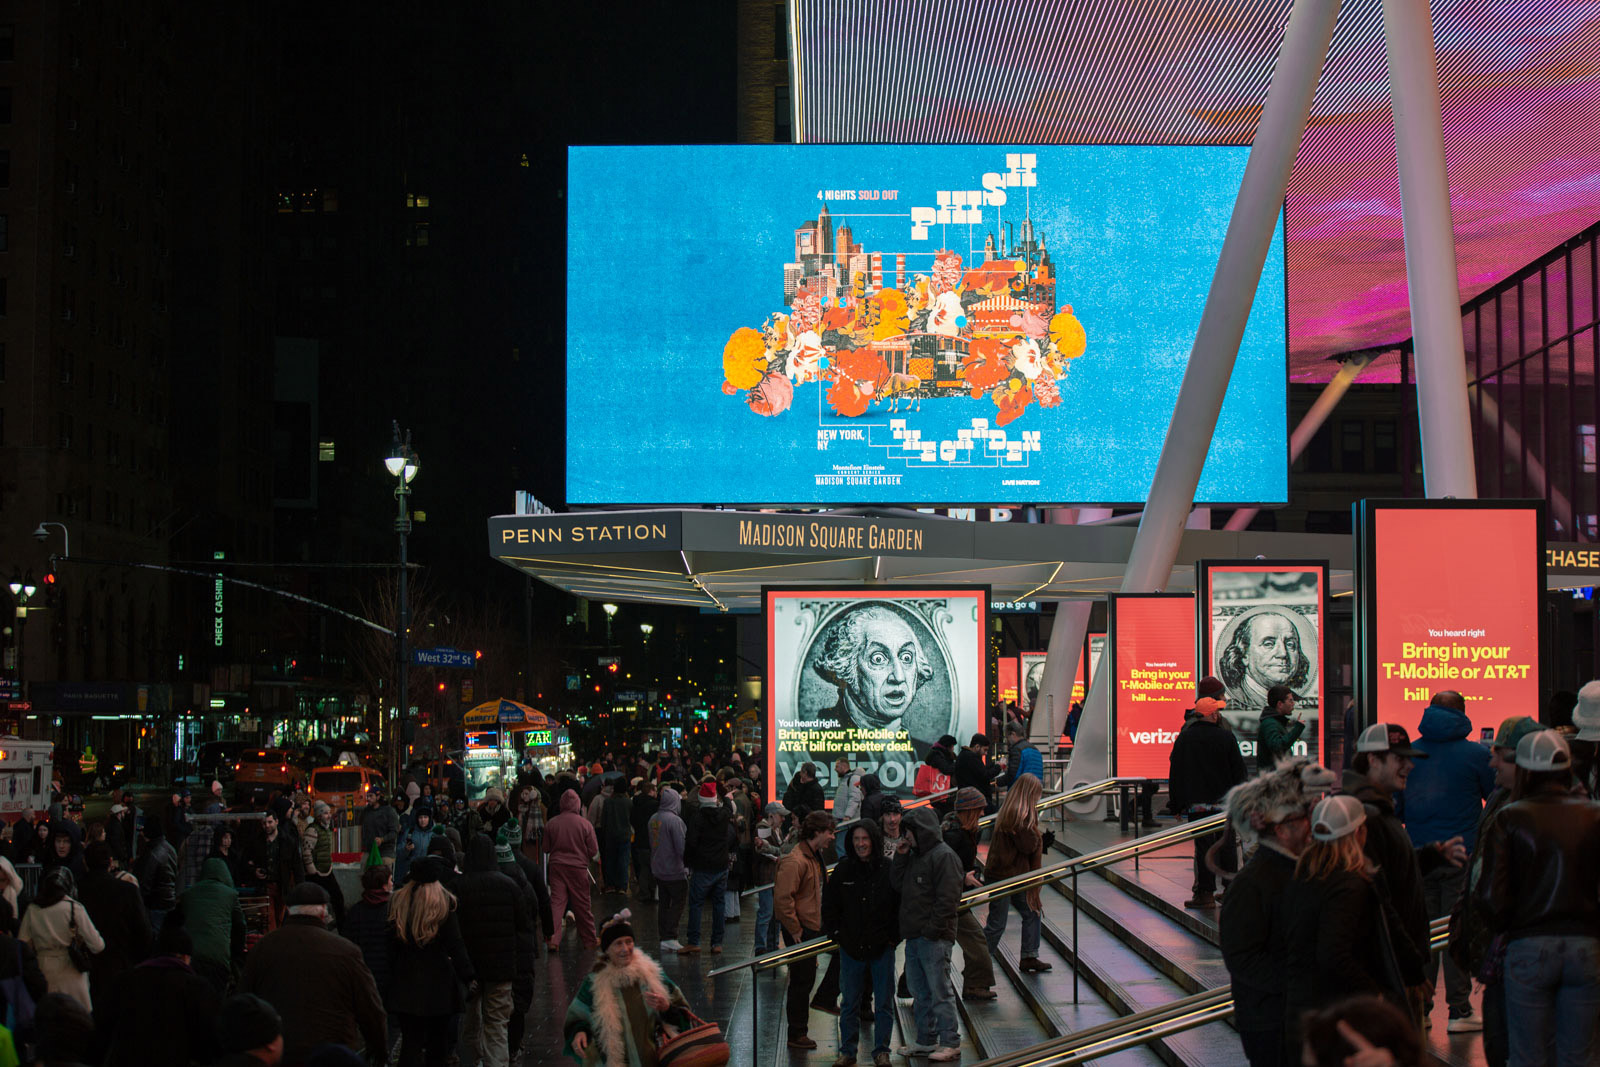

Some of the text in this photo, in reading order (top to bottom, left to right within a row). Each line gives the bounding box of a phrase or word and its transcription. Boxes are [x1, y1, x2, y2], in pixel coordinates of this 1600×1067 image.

[817, 190, 899, 200] 4 NIGHTS SOLD OUT
[911, 153, 1037, 240] PHISH
[818, 430, 865, 441] NEW YORK,
[890, 418, 1041, 461] THE GARDEN
[817, 441, 829, 450] NY
[815, 477, 901, 486] MADISON SQUARE GARDEN
[502, 524, 667, 544] PENN STATION
[739, 520, 923, 550] MADISON SQUARE GARDEN
[1015, 602, 1027, 610] go
[214, 617, 223, 647] CHECK
[1428, 629, 1486, 638] You heard right
[1402, 642, 1511, 663] Bring in your
[418, 652, 471, 665] West 32nd St
[1131, 669, 1191, 680] Bring in your
[1382, 662, 1531, 679] T-Mobile or AT&T
[1120, 680, 1162, 690] T-Mobile
[1175, 681, 1196, 690] AT&
[778, 719, 841, 729] You heard right.
[778, 729, 908, 742] Bring in your T-Mobile or
[778, 741, 913, 751] AT&T bill for a better deal.
